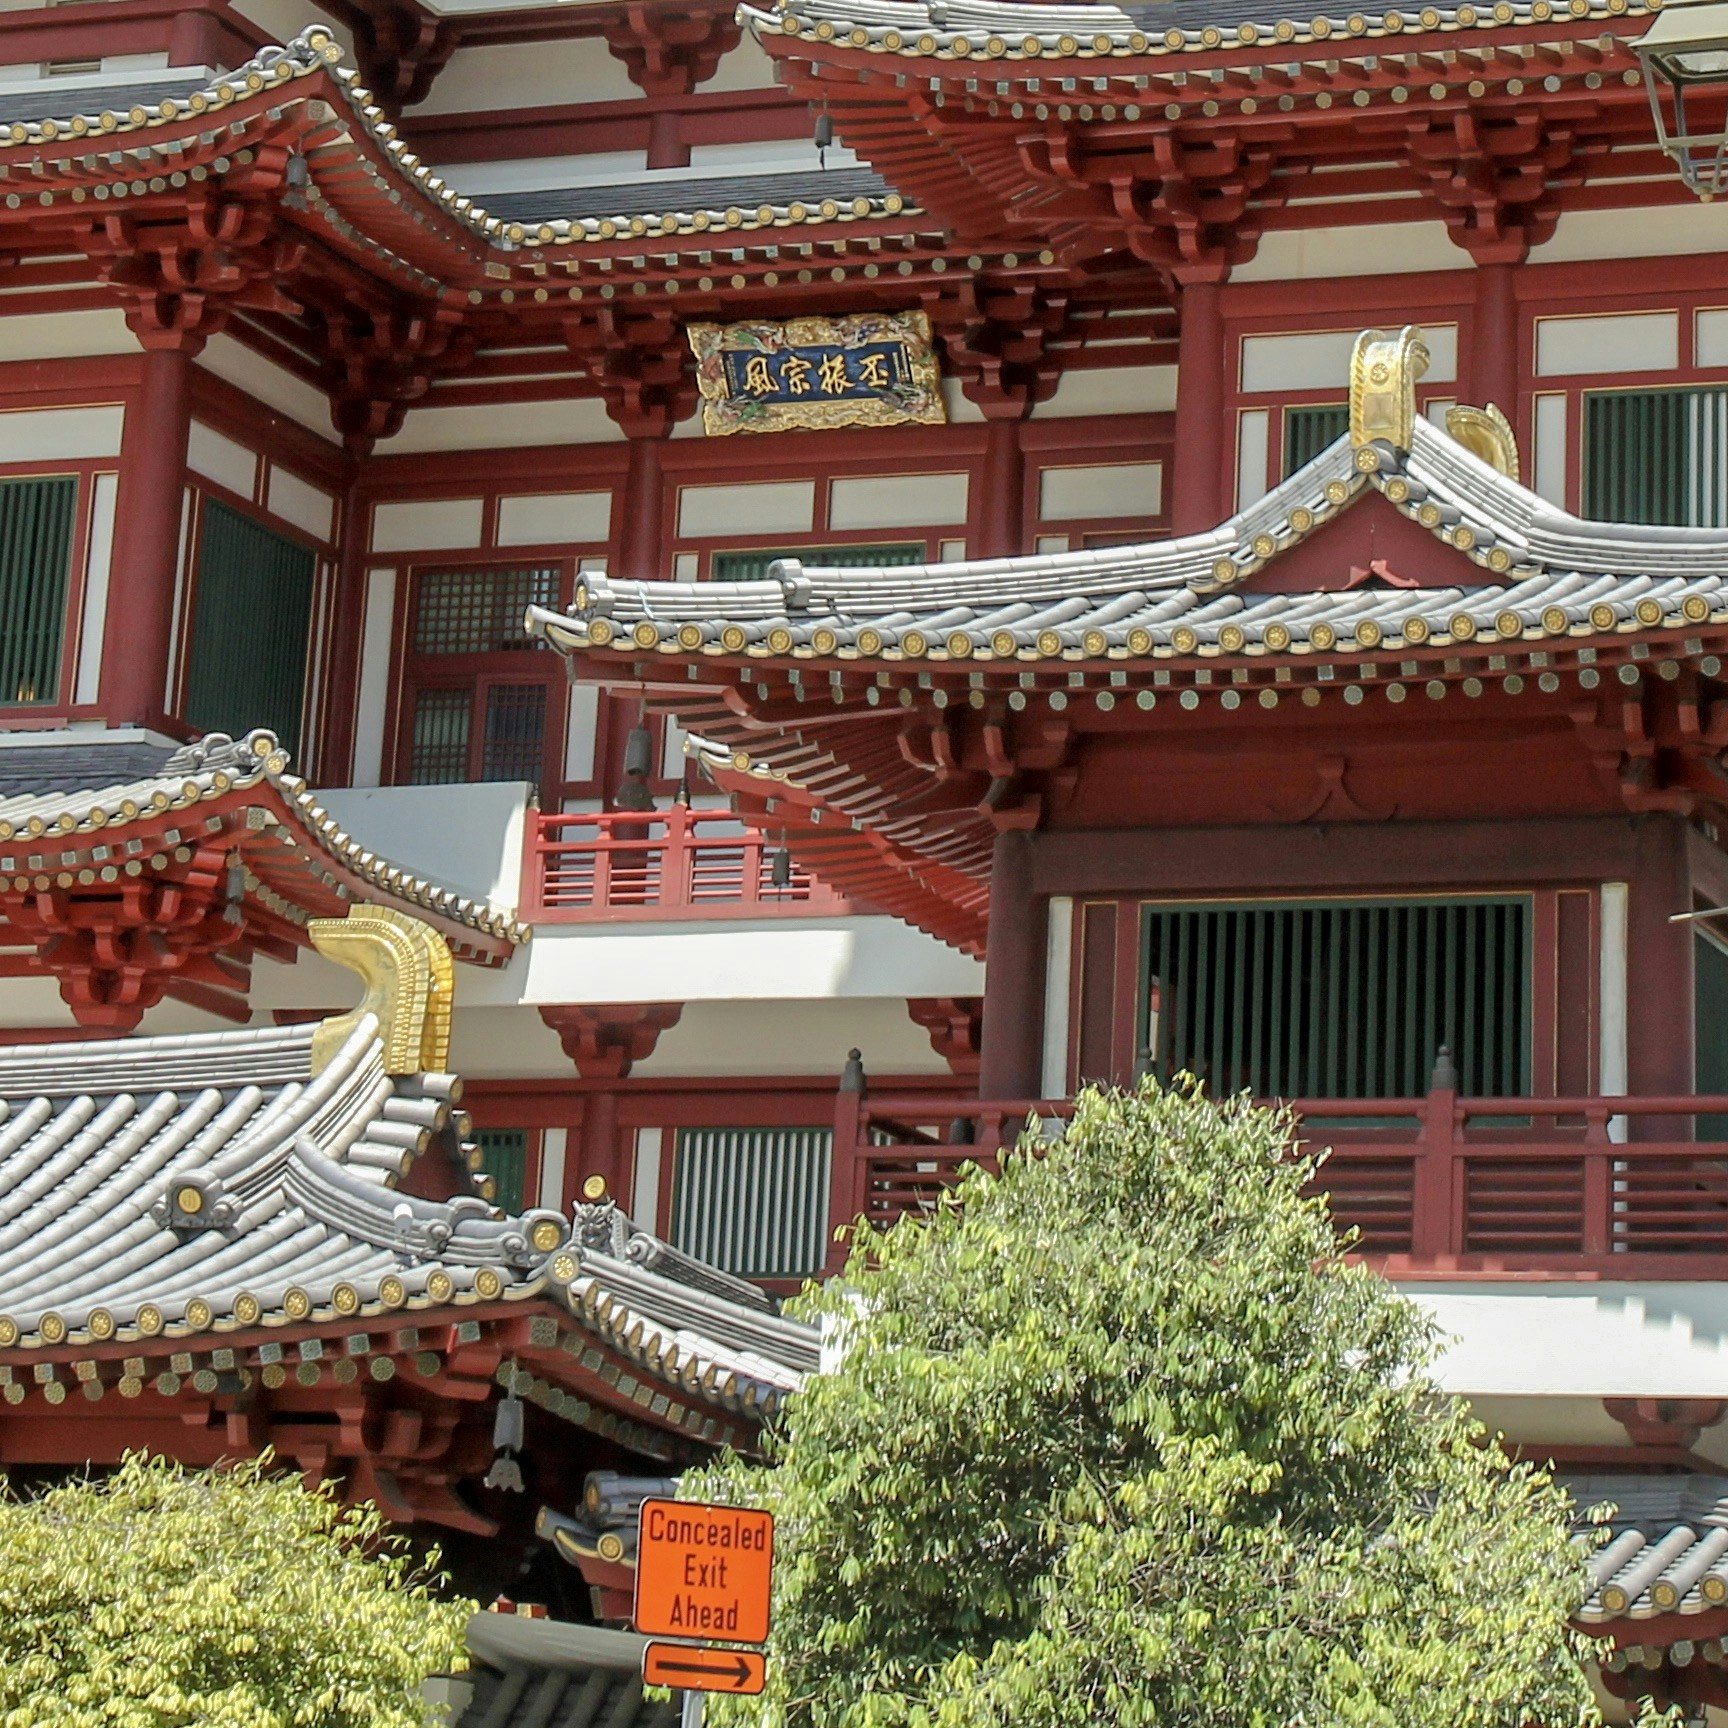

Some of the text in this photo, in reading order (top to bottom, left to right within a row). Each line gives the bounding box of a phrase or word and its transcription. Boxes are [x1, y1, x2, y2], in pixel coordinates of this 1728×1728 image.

[649, 1509, 766, 1551] Concealed
[684, 1553, 727, 1589] Exit
[670, 1594, 738, 1631] Ahead
